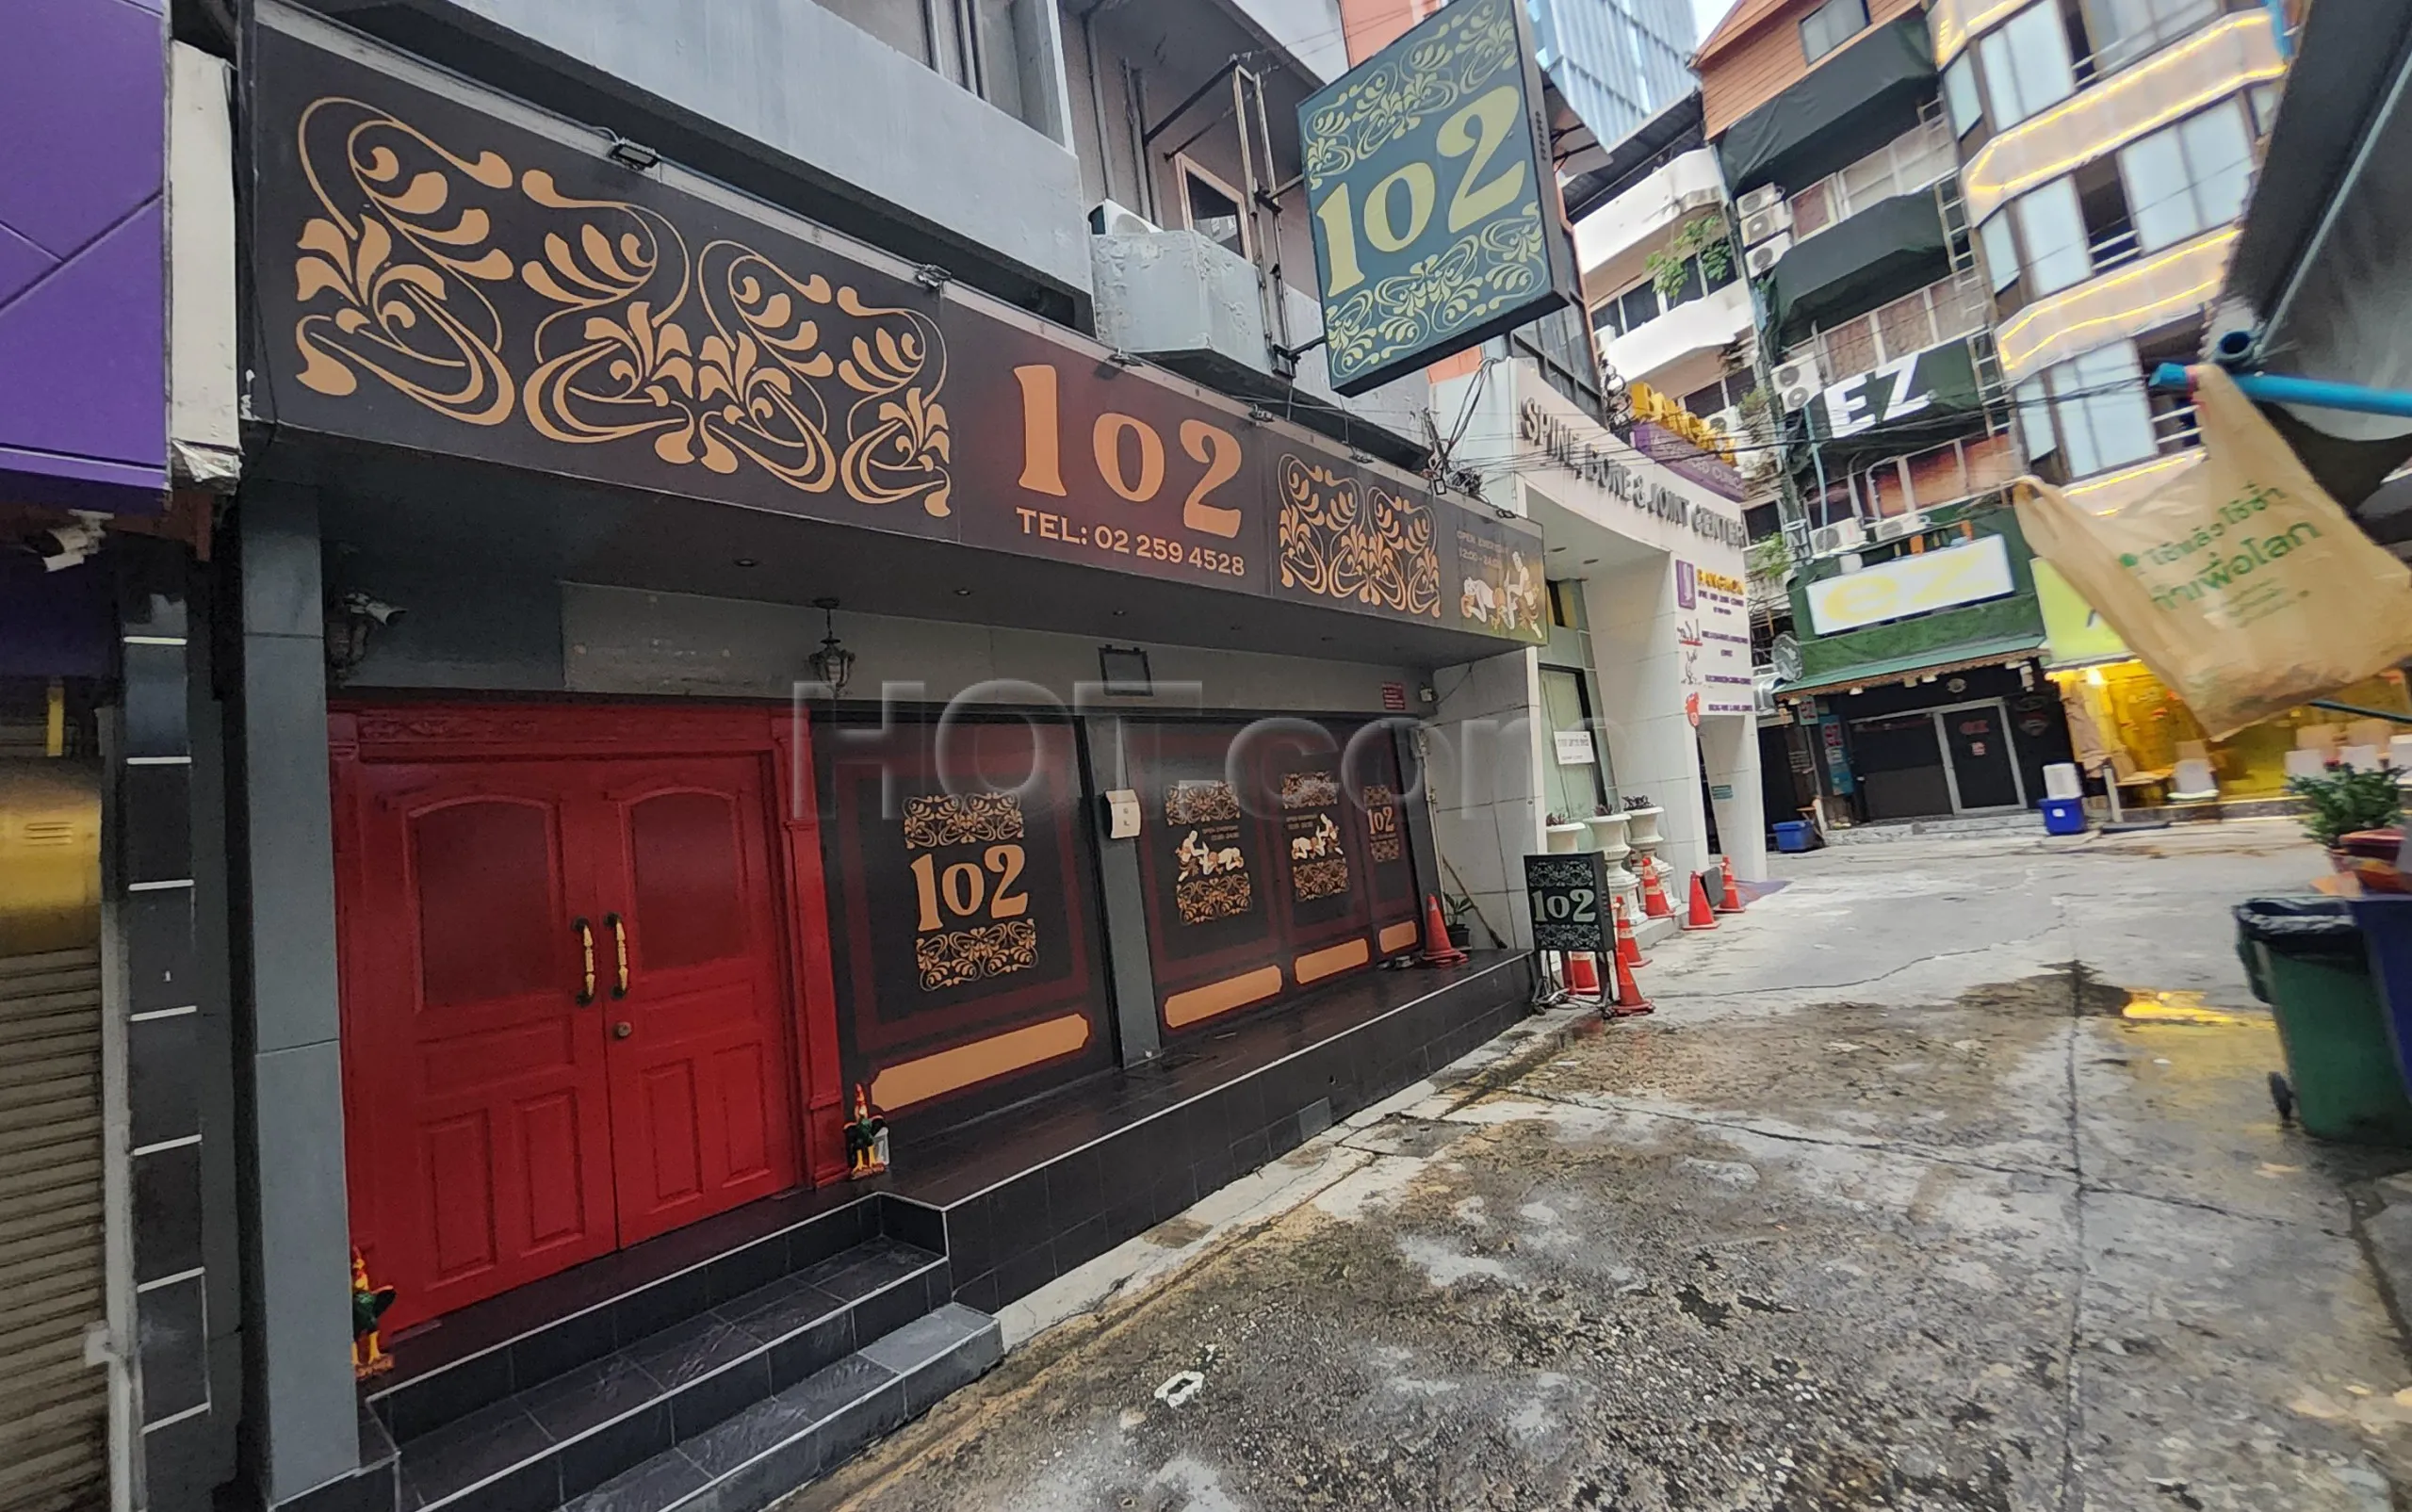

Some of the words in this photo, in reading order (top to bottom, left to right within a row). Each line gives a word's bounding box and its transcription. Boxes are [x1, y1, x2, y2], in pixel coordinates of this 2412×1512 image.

[1317, 86, 1525, 297] 102
[1824, 352, 1930, 438] EZ
[1014, 364, 1242, 538] 102
[1017, 507, 1087, 545] TEL:
[1094, 526, 1130, 554] 02
[1136, 535, 1183, 563] 259
[1189, 547, 1245, 577] 4528
[1632, 475, 1646, 509] &
[1647, 483, 1689, 528] JOINT
[1691, 504, 1746, 548] CENTER
[1367, 806, 1394, 835] 102
[910, 844, 1028, 932] 102
[1531, 888, 1596, 922] 102
